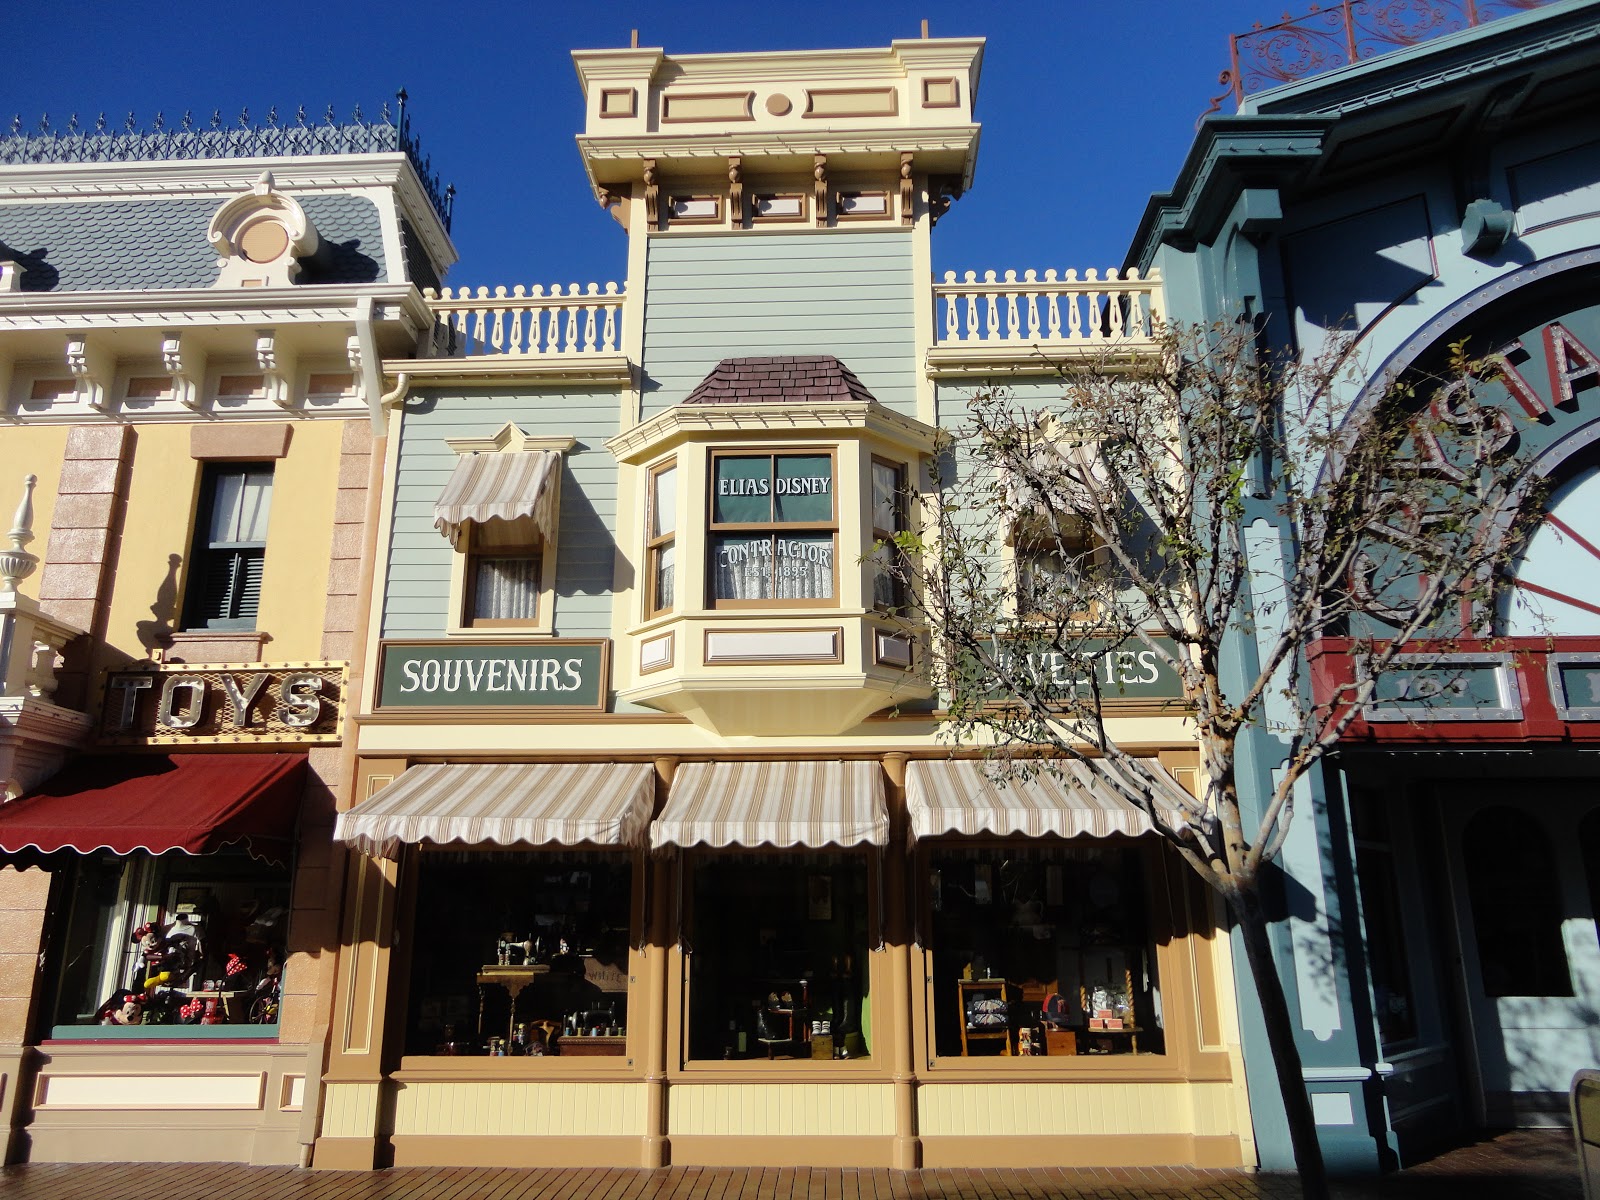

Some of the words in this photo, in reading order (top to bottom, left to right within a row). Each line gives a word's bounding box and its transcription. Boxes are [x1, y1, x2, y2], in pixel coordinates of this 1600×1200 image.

[719, 478, 770, 496] ELIAS
[776, 477, 831, 495] DISNEY
[720, 538, 831, 568] CONTRACTOR
[744, 566, 771, 578] EST.
[778, 566, 808, 578] 1895
[400, 658, 583, 692] SOUVENIRS
[111, 672, 323, 728] TOYS
